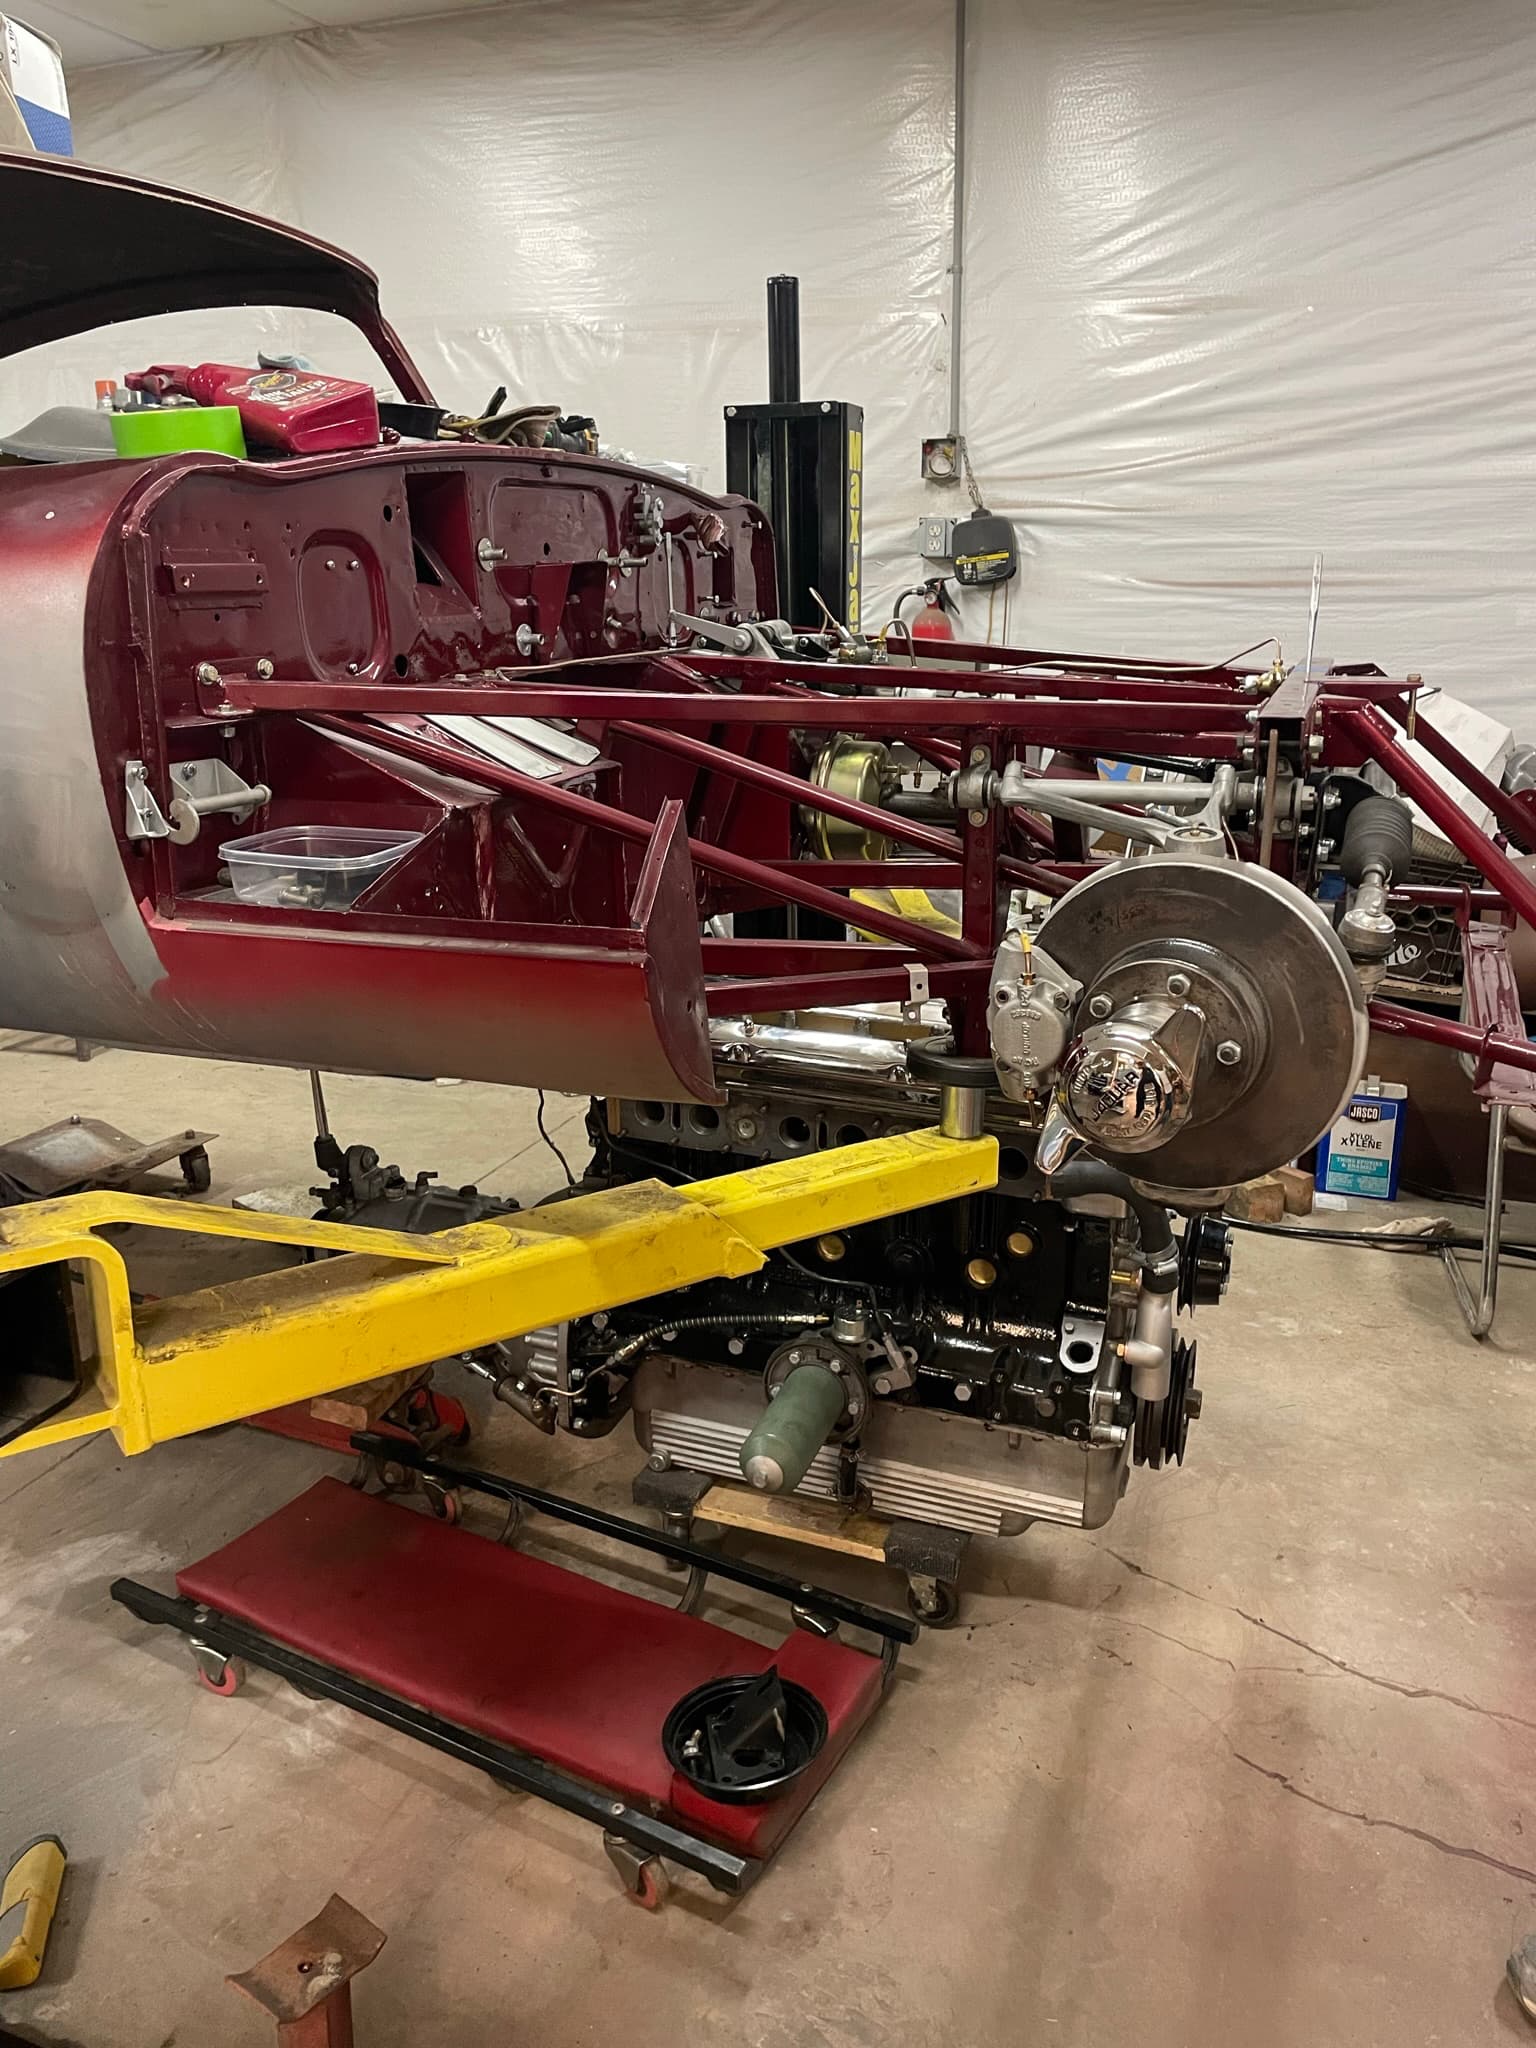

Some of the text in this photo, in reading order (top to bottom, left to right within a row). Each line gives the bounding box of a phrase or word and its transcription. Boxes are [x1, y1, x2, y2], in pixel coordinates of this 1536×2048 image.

[849, 430, 862, 633] MaxJa
[1092, 1071, 1140, 1122] JAGUAR
[1350, 1106, 1379, 1120] JASCO
[1340, 1137, 1383, 1150] XYLENE
